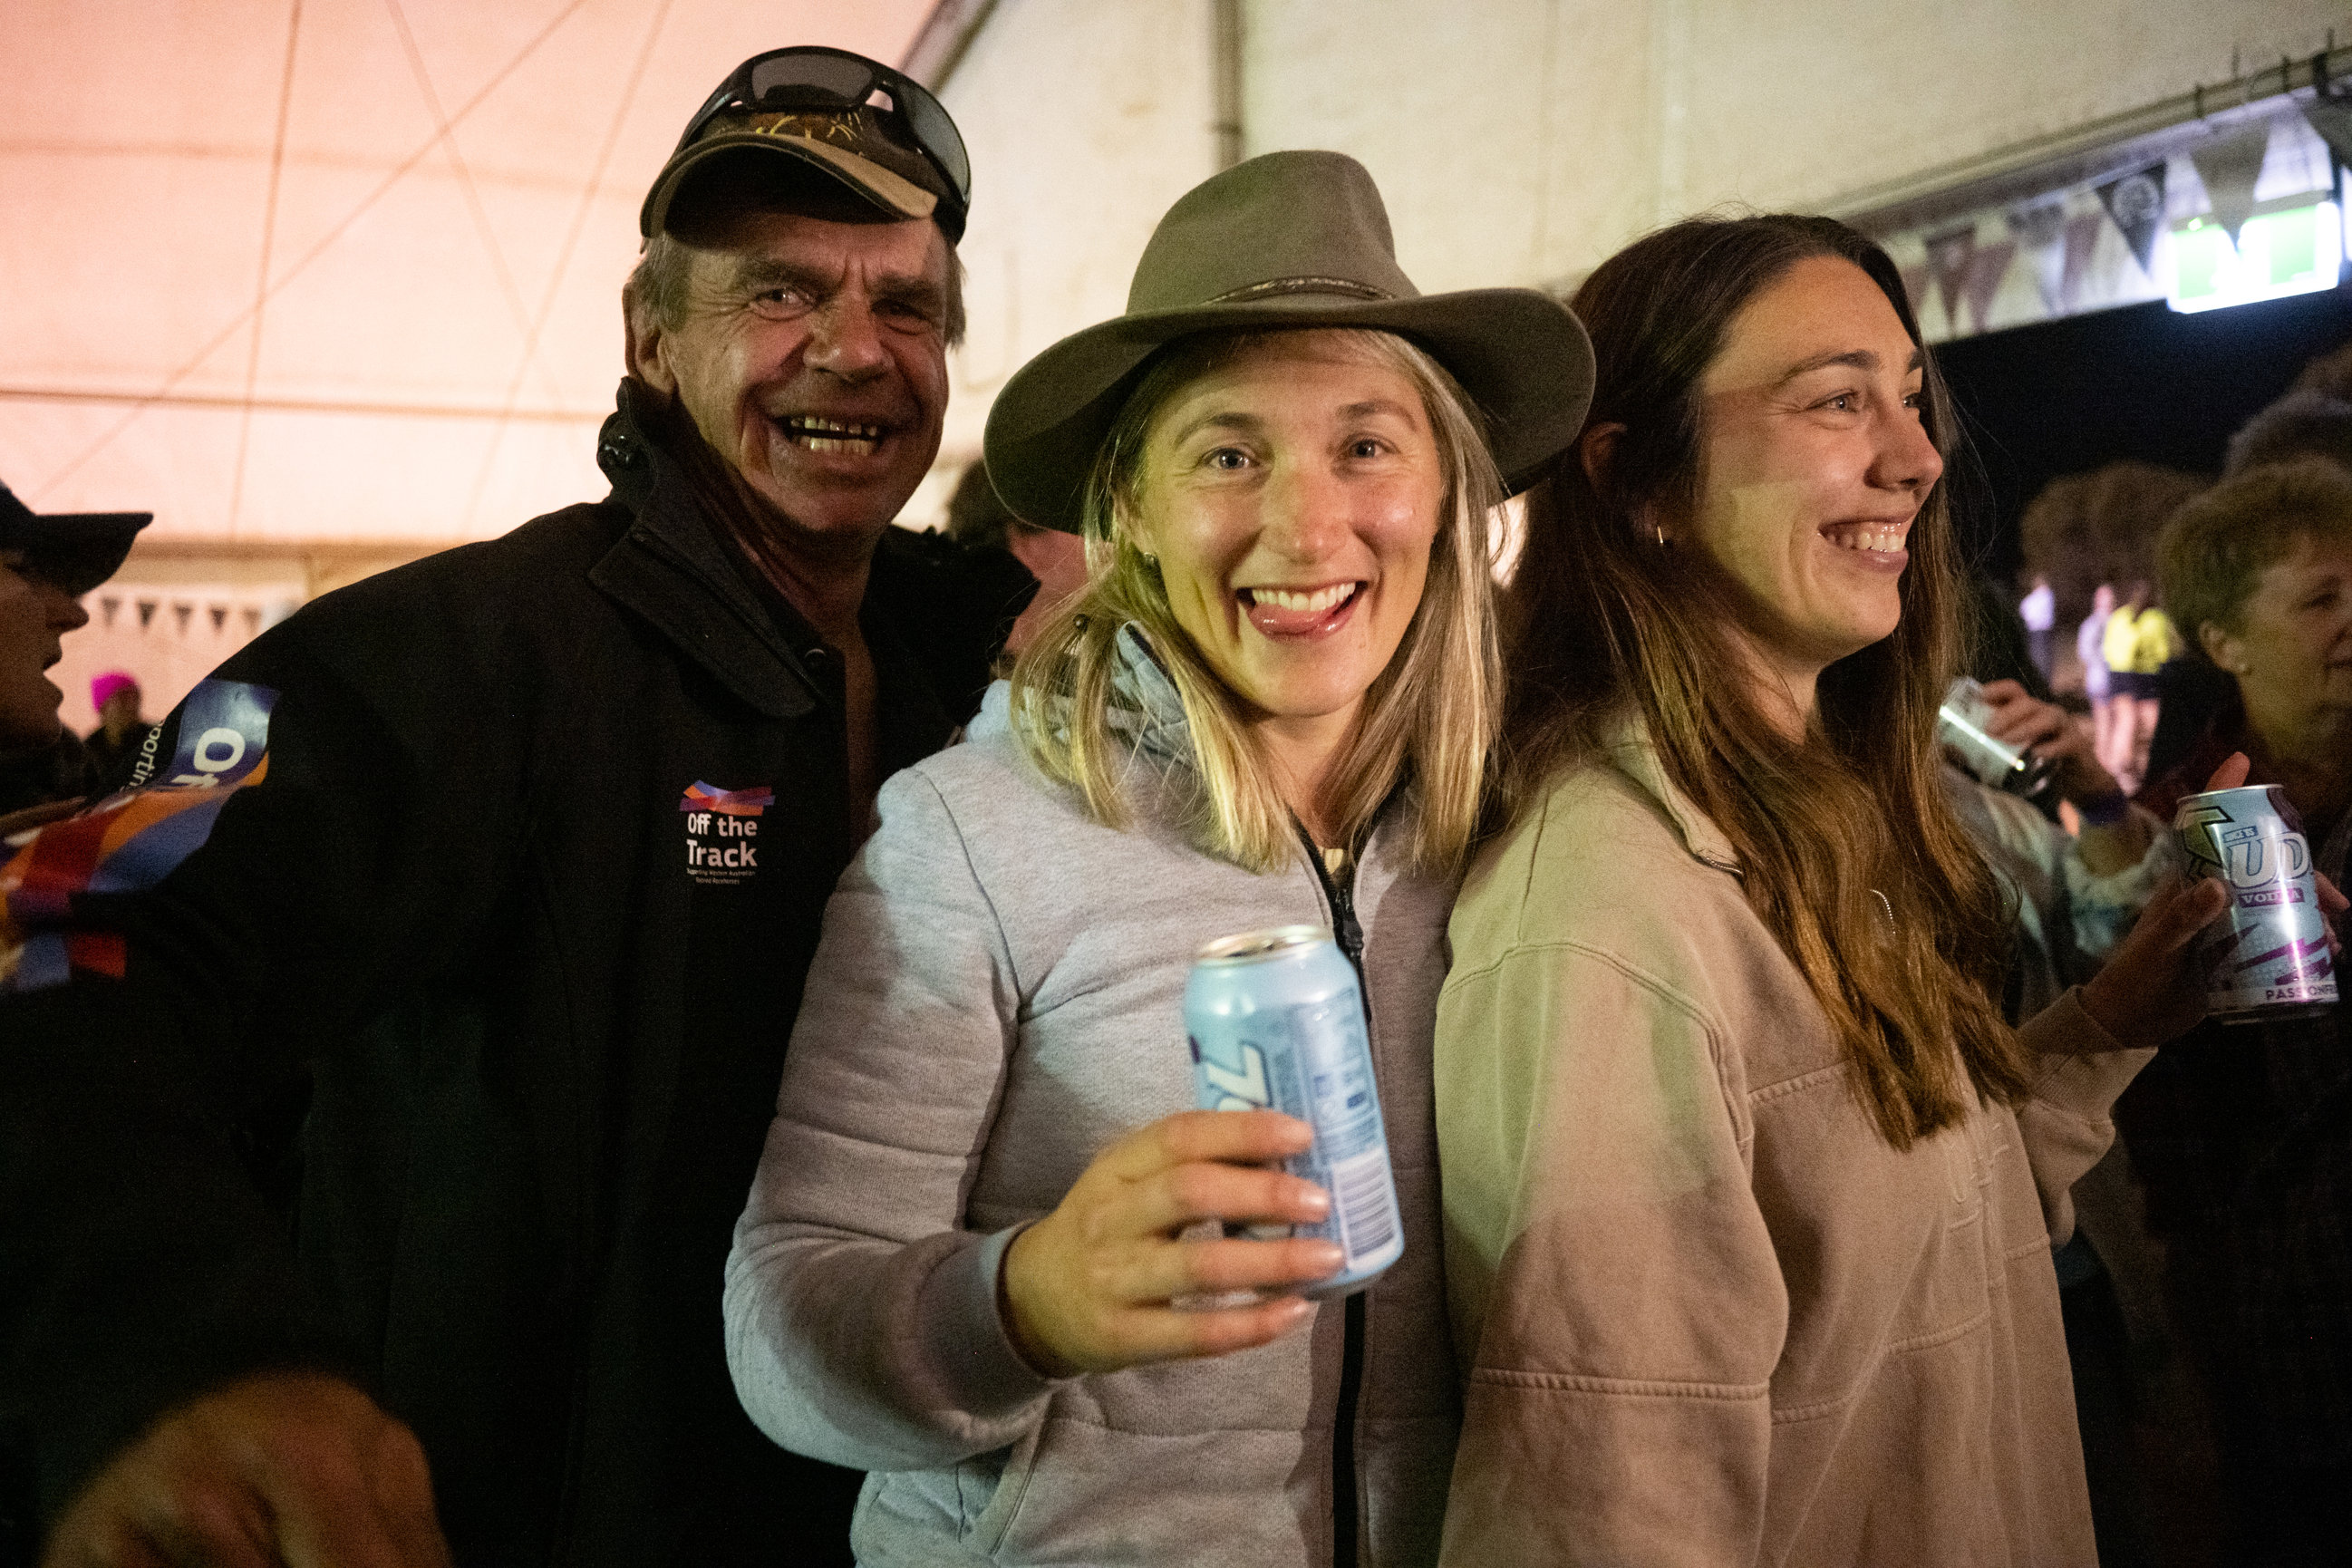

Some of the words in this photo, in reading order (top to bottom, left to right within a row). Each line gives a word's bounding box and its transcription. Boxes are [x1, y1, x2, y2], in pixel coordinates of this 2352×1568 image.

[687, 812, 712, 836] Off
[717, 815, 758, 837] the
[686, 838, 759, 867] Track
[2241, 886, 2302, 904] VODA
